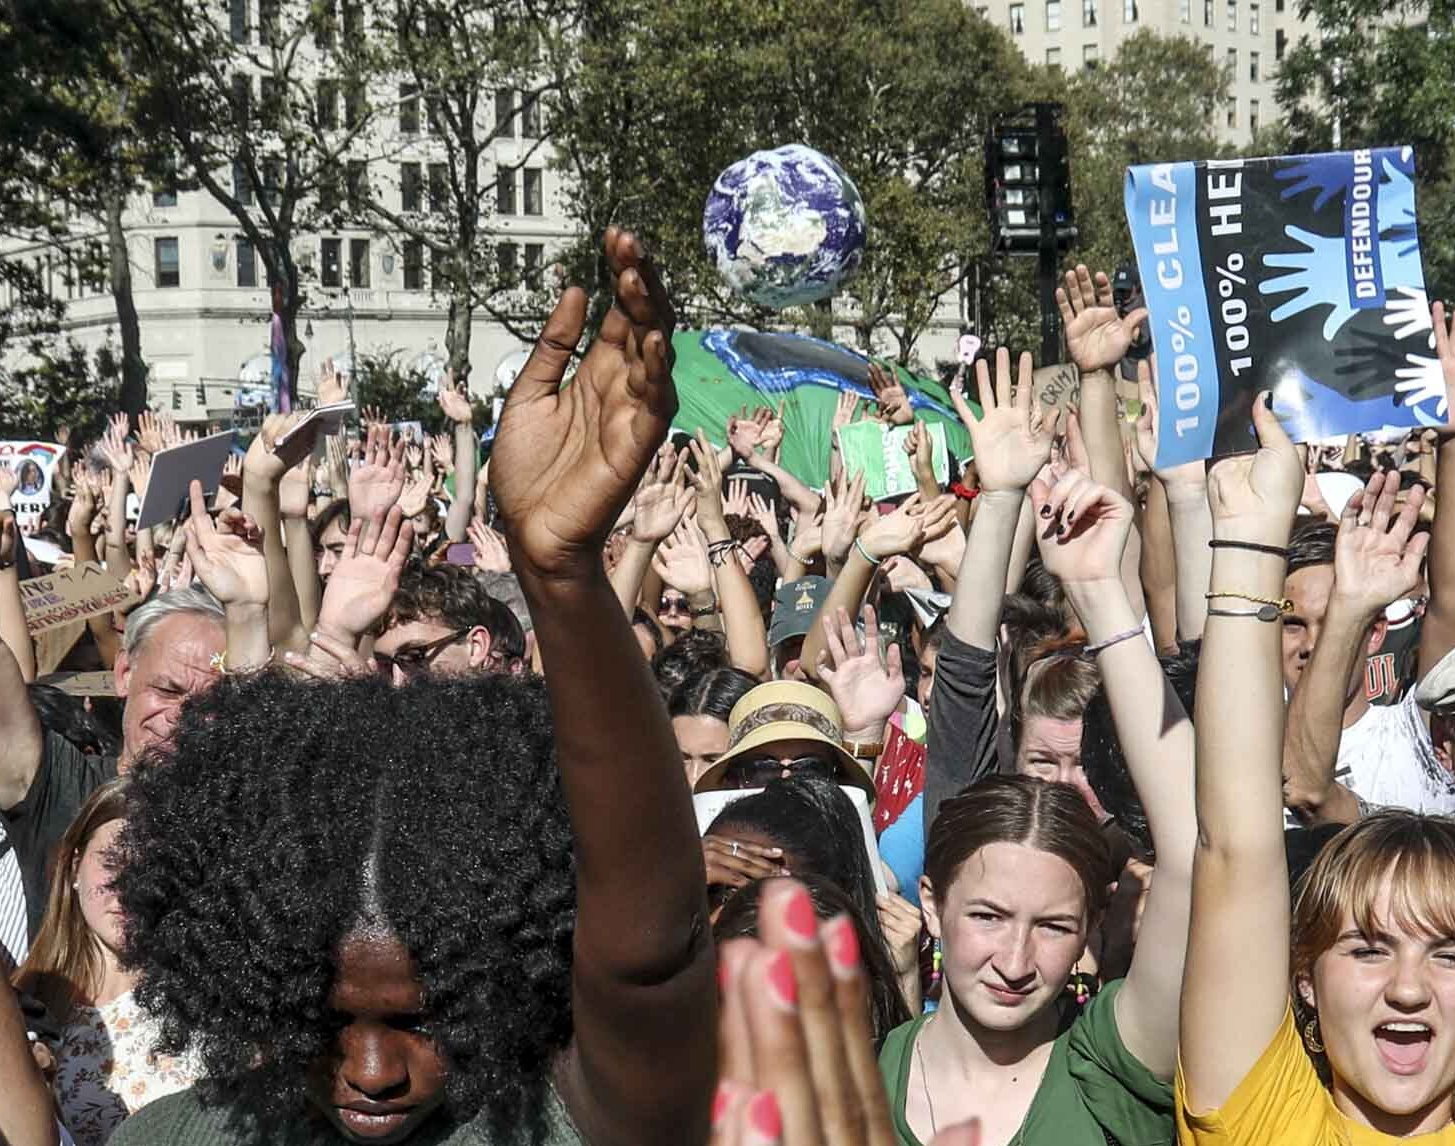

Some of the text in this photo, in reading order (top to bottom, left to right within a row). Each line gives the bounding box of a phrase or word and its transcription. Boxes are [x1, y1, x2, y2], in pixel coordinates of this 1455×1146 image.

[1150, 162, 1202, 437] 100% CLEA
[1217, 252, 1252, 377] 100%
